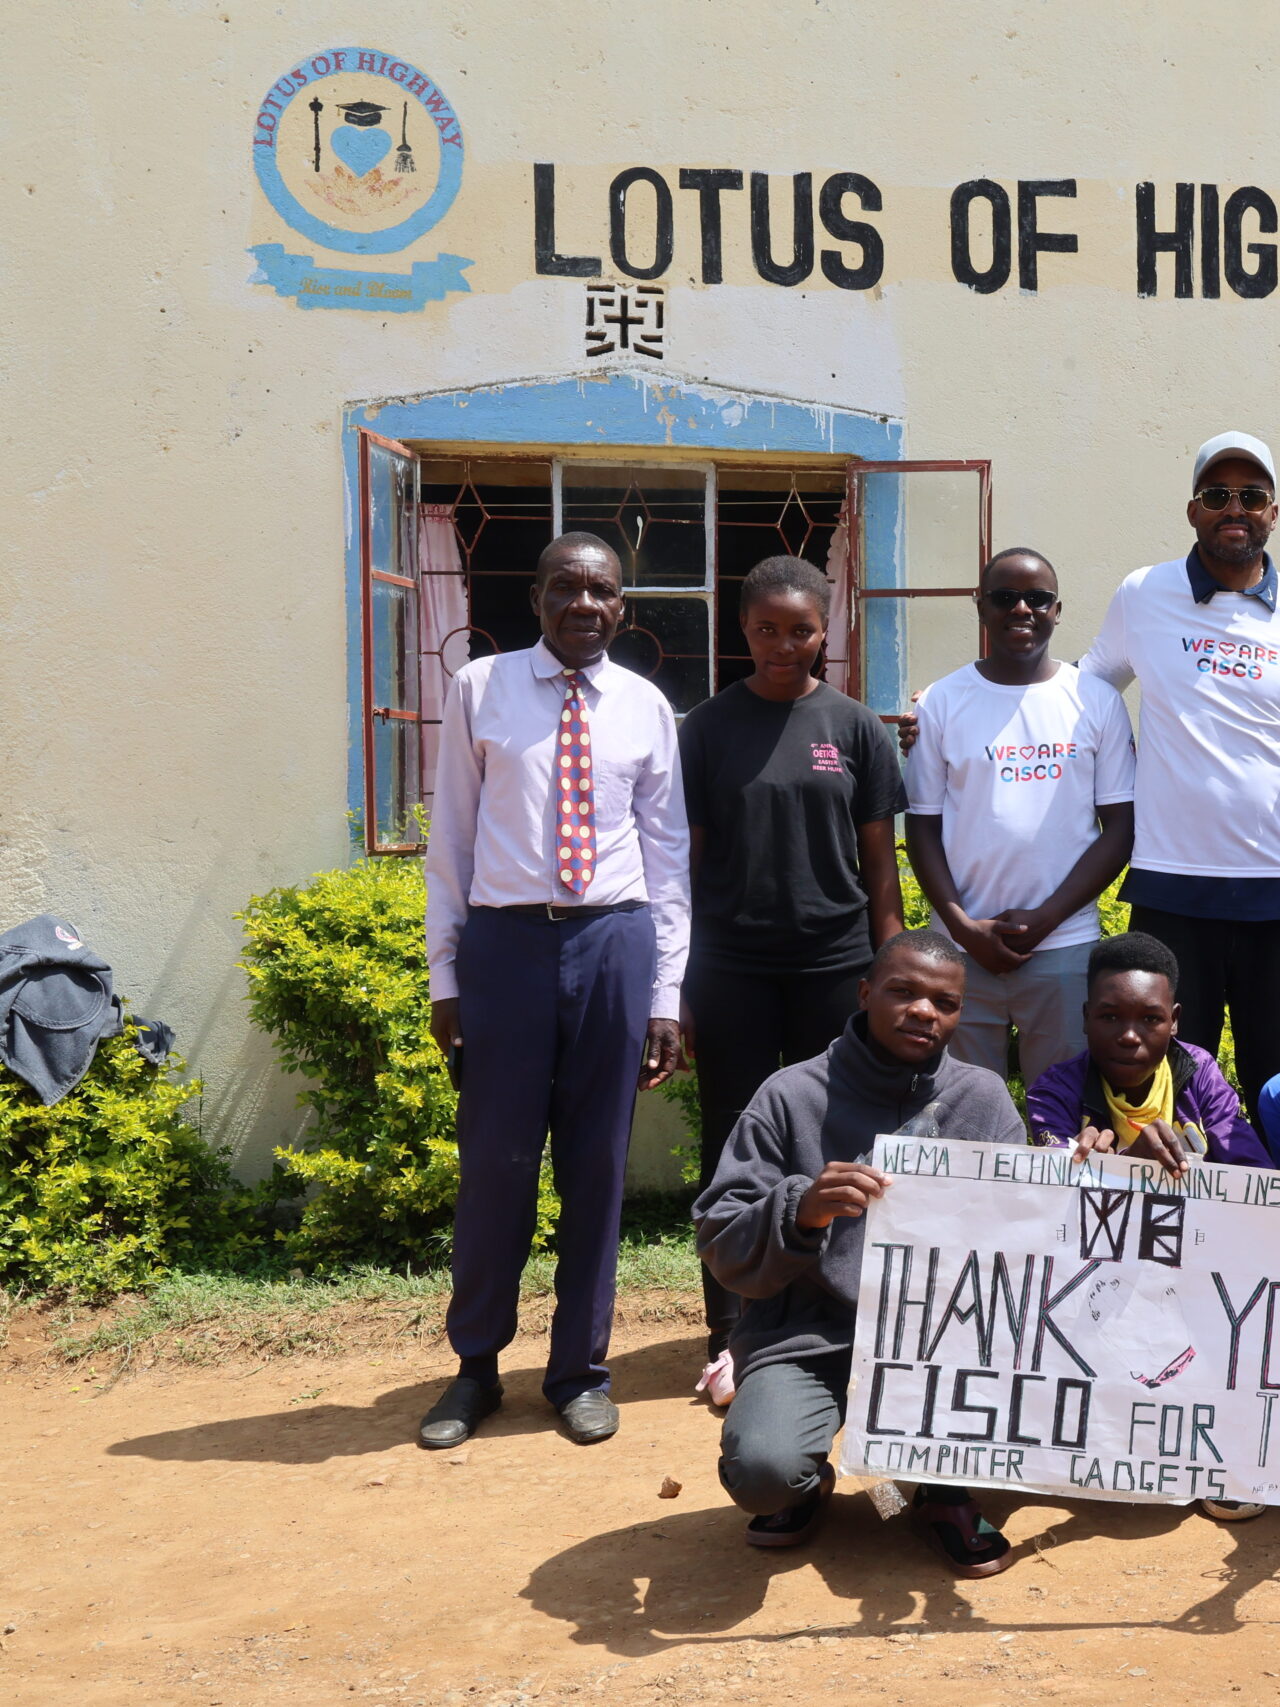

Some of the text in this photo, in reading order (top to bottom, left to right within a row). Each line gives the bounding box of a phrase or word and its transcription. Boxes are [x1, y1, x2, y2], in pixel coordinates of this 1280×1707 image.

[254, 52, 463, 149] LOTUS OF HIGHWAY
[532, 162, 884, 291] LOTUS
[949, 178, 1077, 297] OF
[334, 281, 363, 297] and
[1182, 637, 1279, 665] WE ARE
[1196, 657, 1263, 680] CISCO
[985, 743, 1078, 761] WE ARE
[1000, 763, 1062, 782] CISCO
[883, 1142, 950, 1176] WEMA
[1129, 1164, 1228, 1202] TRAINING
[871, 1242, 1101, 1378] THANK
[866, 1362, 1096, 1449] CISCO
[1129, 1402, 1224, 1463] FOR
[864, 1440, 1024, 1481] COMPUTER
